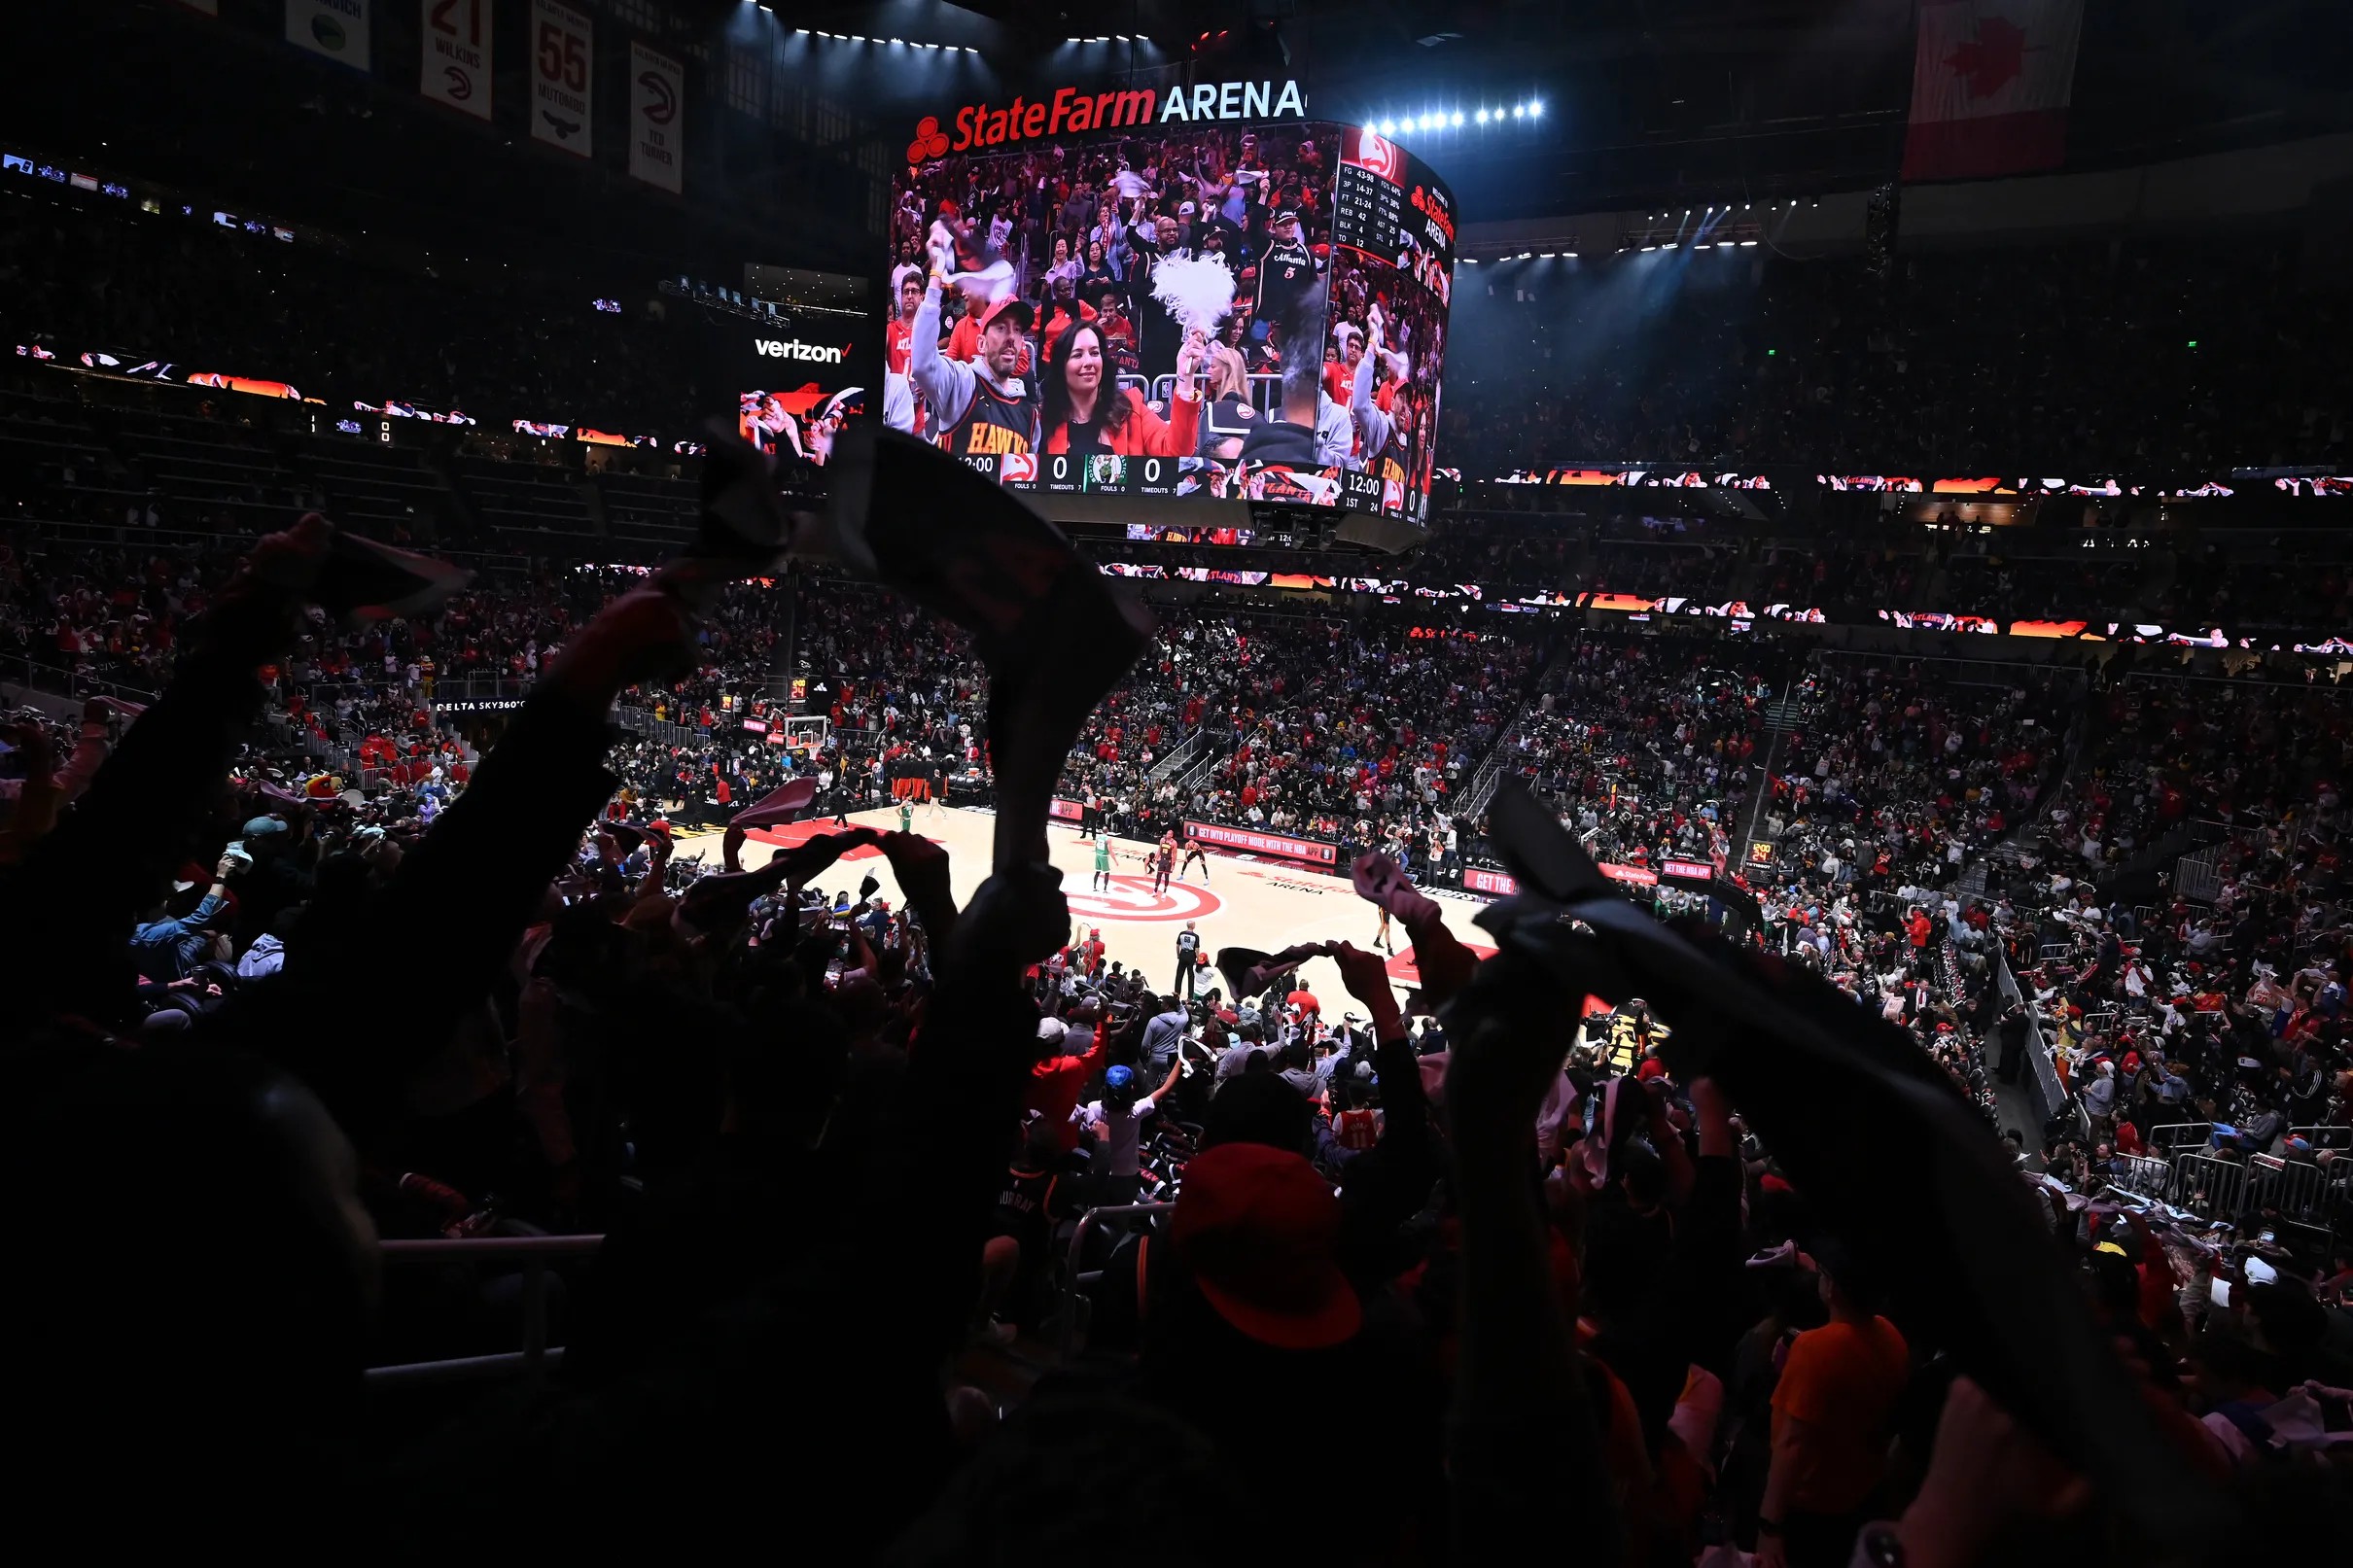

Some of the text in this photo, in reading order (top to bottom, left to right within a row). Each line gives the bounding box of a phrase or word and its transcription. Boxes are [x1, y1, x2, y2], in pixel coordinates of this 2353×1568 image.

[436, 36, 480, 69] WILKINS
[539, 20, 585, 92] 55
[538, 83, 585, 115] MUTOMBO
[1160, 80, 1304, 122] ARENA
[641, 142, 673, 166] TURNER
[1344, 166, 1352, 175] FG
[1356, 183, 1373, 195] 14-37
[1354, 196, 1372, 209] 21-24
[1340, 207, 1367, 222] REB 42
[1339, 221, 1363, 234] BLK 4
[1338, 233, 1364, 248] TO 12
[1274, 253, 1306, 267] Atlanta
[1284, 266, 1297, 280] 5
[755, 338, 841, 364] verizon
[1053, 456, 1068, 479] 0
[1145, 458, 1161, 482] 0
[1349, 473, 1380, 496] 12:00
[1346, 490, 1416, 512] 1ST 24 0
[791, 686, 804, 698] 24
[437, 702, 475, 712] DELTA
[1061, 805, 1073, 817] APP
[1199, 827, 1319, 856] GET INTO PLAYOFF MODE WITH THE NBA APP
[1752, 851, 1767, 860] 24
[1665, 863, 1674, 873] GET
[1675, 864, 1685, 874] THE
[1698, 866, 1709, 877] APP
[1266, 882, 1323, 895] ARENA
[1476, 873, 1493, 890] GET
[1494, 876, 1512, 893] THE
